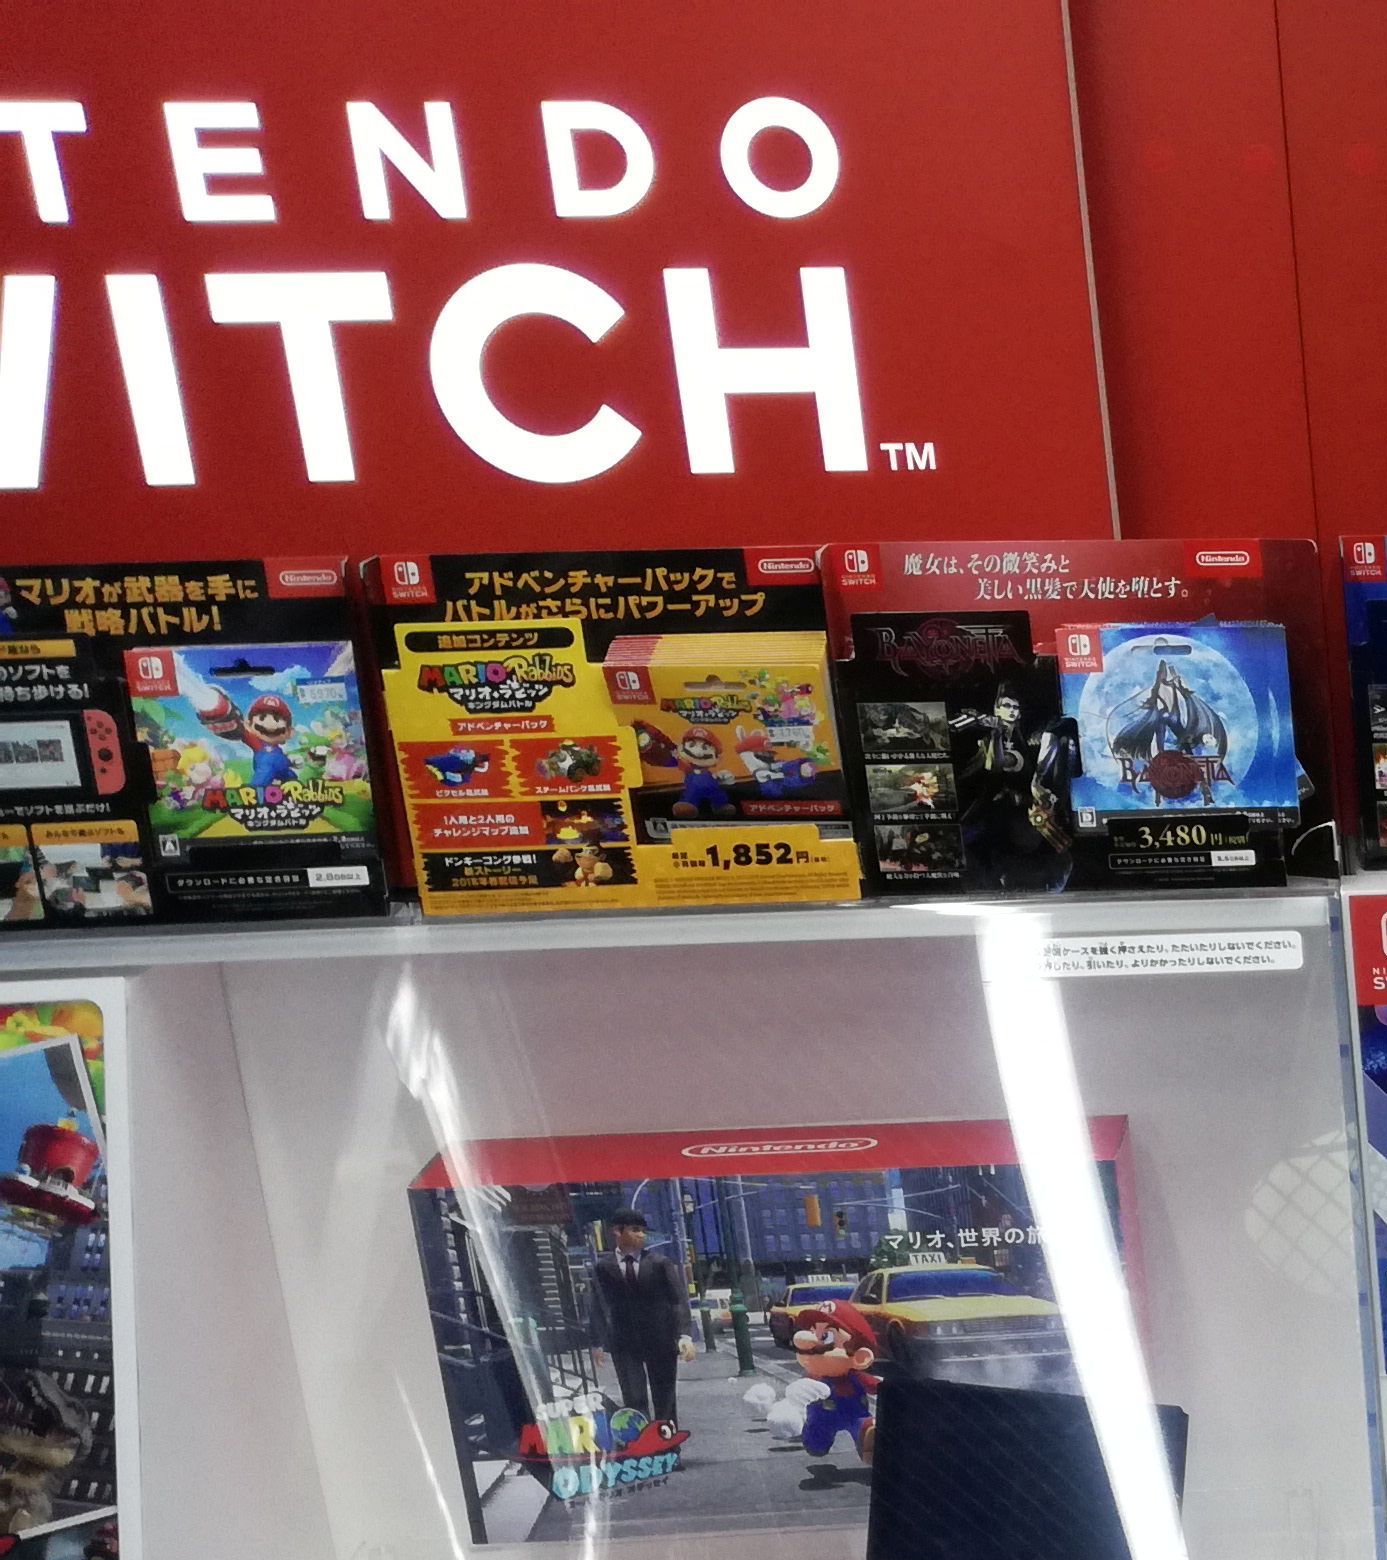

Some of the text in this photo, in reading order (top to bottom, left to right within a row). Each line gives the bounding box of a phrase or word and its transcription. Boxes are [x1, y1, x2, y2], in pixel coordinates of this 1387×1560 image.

[904, 552, 1069, 576] 魔女は、その微笑みと
[15, 575, 259, 606] マリオが武器を手に
[465, 568, 736, 596] アドベンチャーパックで
[976, 577, 1188, 600] 美しい黒髪で天使を堕とす。
[445, 591, 765, 623] バトルがさらにパワーアップ
[421, 663, 506, 688] MARIO
[205, 787, 281, 810] MARIO
[701, 1140, 864, 1155] Nintendo
[911, 1252, 944, 1265] TAXI
[552, 1452, 679, 1500] ODYSSEY
